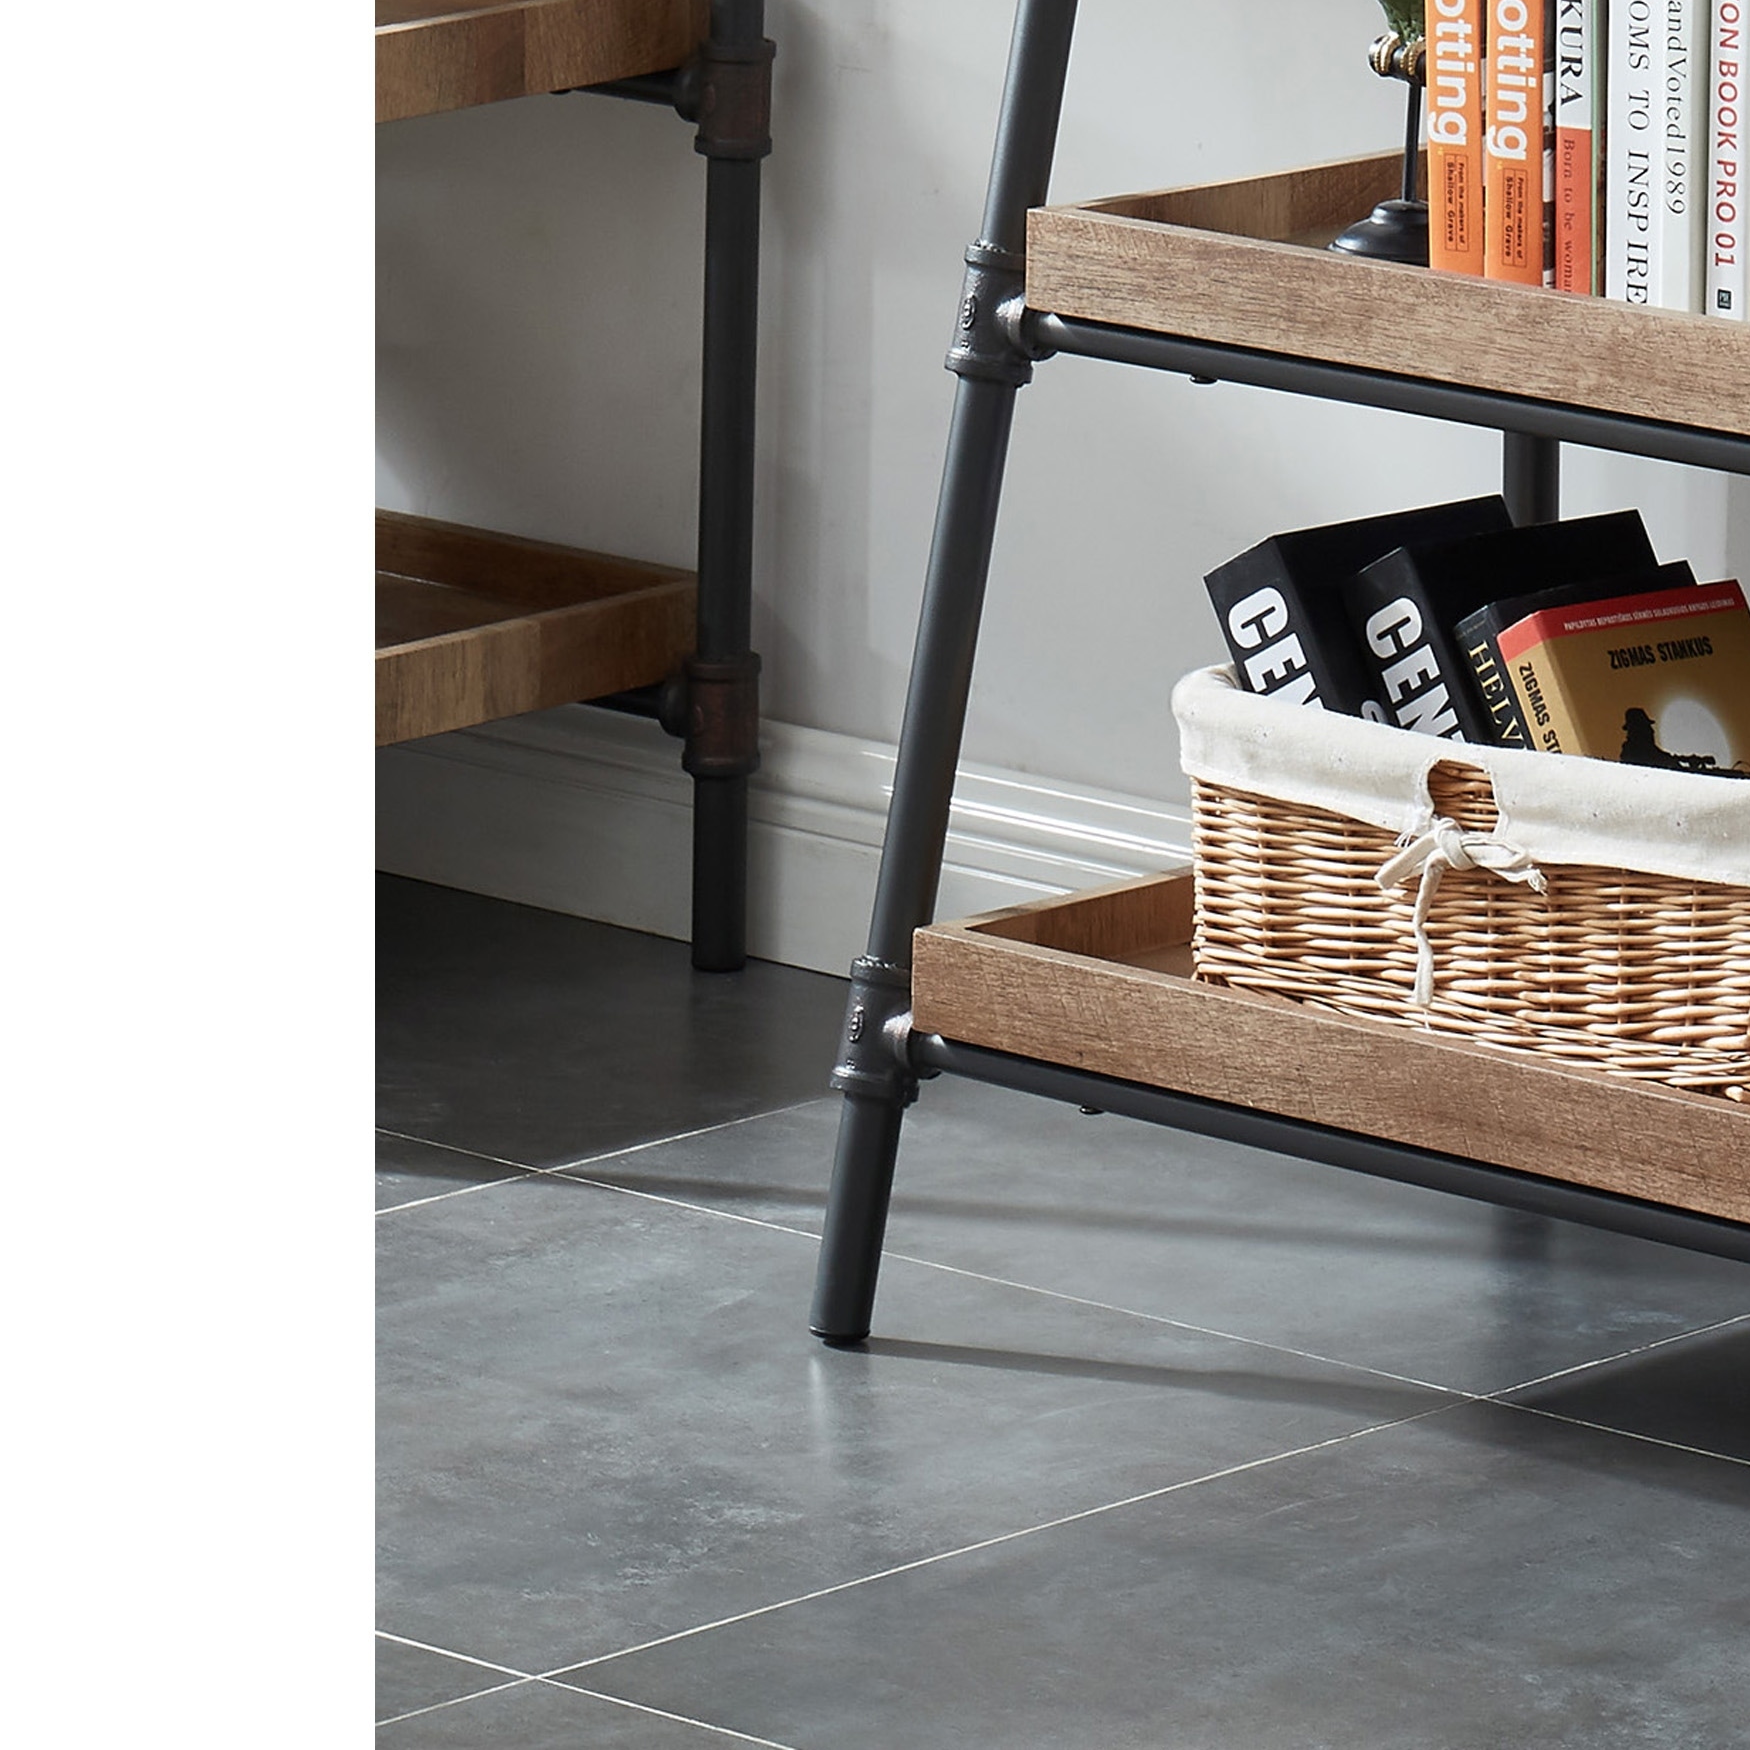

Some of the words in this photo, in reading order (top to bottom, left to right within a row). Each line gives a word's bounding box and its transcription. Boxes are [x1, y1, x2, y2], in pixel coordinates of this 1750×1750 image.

[1627, 90, 1649, 131] TO
[1717, 61, 1740, 150] BOOK
[1457, 162, 1465, 183] From
[1563, 138, 1576, 179] Born
[1446, 162, 1455, 205] Shallow
[1457, 186, 1465, 199] the
[1505, 176, 1514, 219] Shallow
[1516, 177, 1524, 198] From
[1563, 187, 1574, 203] to
[1716, 161, 1738, 223] PRO
[1516, 201, 1524, 214] the
[1563, 212, 1577, 230] be
[1446, 210, 1455, 243] Grave
[1457, 234, 1466, 244] of
[1505, 225, 1513, 257] Grave
[1516, 248, 1524, 259] of
[1715, 232, 1736, 268] 01
[1607, 646, 1656, 669] ZIGMAS
[1659, 636, 1714, 664] STANKUS
[1366, 597, 1468, 743] CEN
[1468, 640, 1527, 749] HELV
[1519, 662, 1551, 727] ZIGMAS
